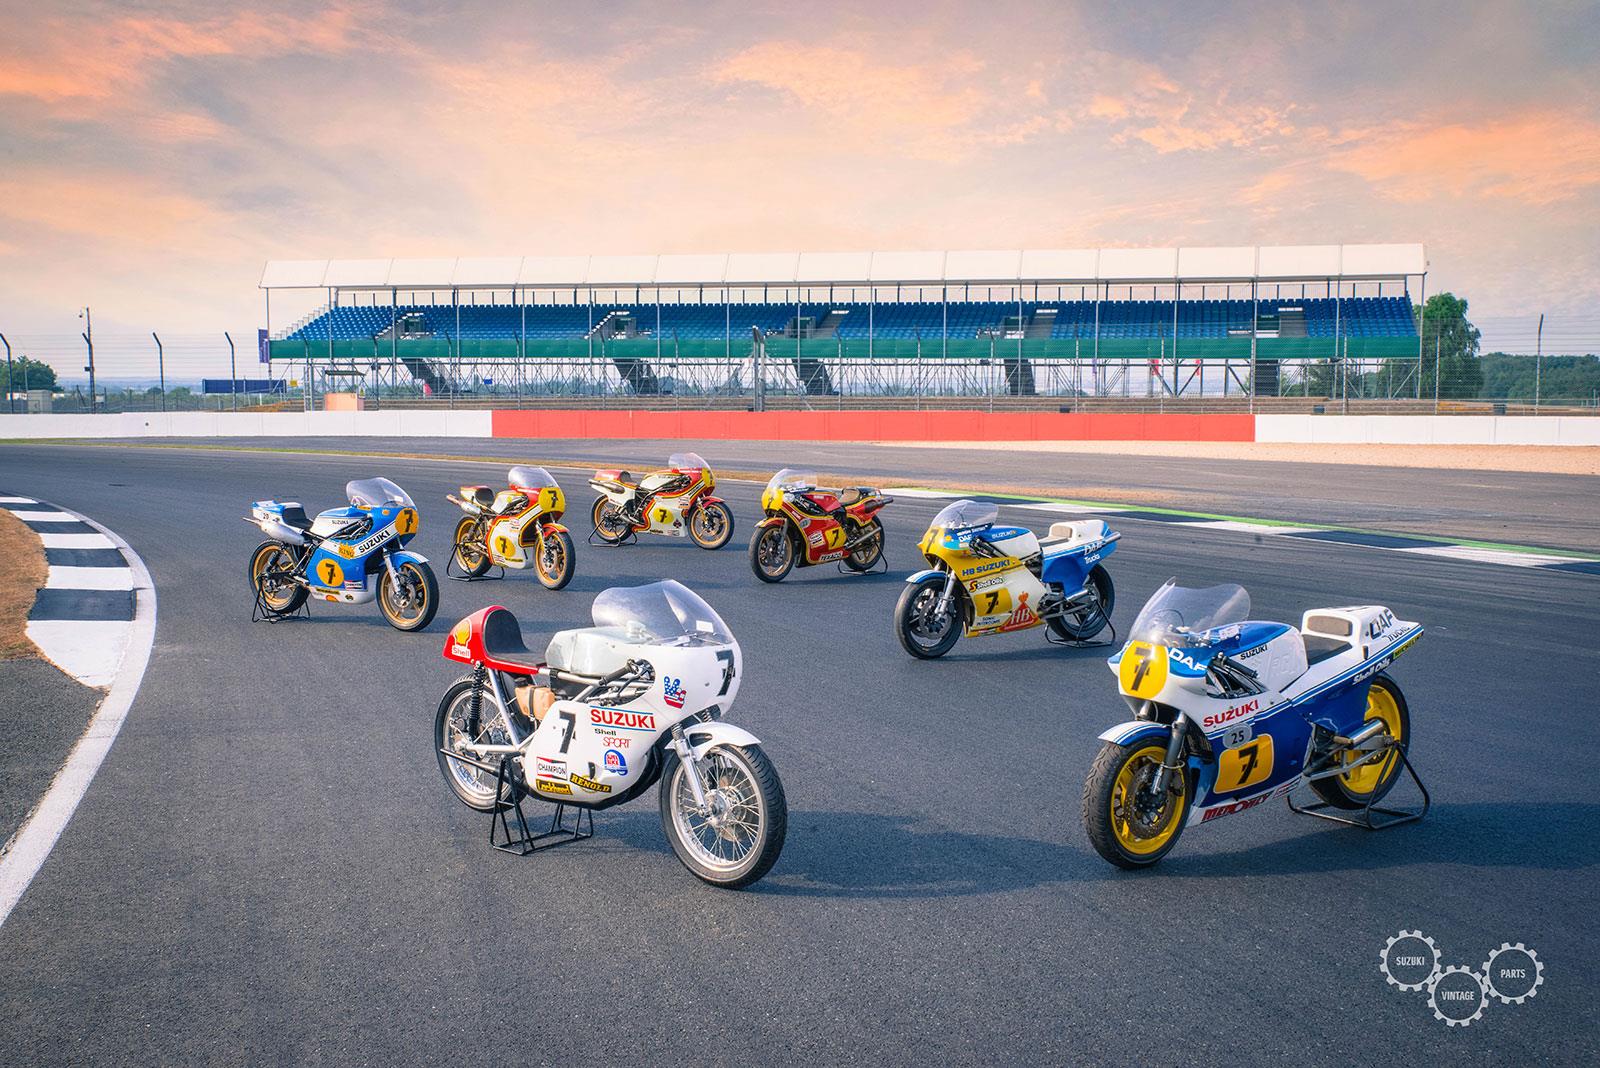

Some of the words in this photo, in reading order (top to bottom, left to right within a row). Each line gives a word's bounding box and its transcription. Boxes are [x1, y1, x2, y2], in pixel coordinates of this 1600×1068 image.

[547, 490, 558, 508] 7
[403, 509, 413, 532] 7
[658, 509, 667, 523] 7
[358, 530, 391, 553] SUZUKI
[499, 537, 507, 554] 7
[831, 529, 839, 546] 7
[926, 529, 939, 552] 7
[325, 562, 336, 585] 7
[962, 567, 975, 577] HB
[976, 559, 1011, 573] SUZUKI
[985, 591, 999, 615] 7
[1010, 607, 1030, 625] HB
[1369, 608, 1393, 640] DAF
[452, 647, 470, 657] Shell
[1168, 647, 1208, 672] DAF
[1240, 645, 1268, 660] SUZUKI
[716, 650, 736, 697] 7
[1131, 646, 1153, 691] 7
[1352, 665, 1375, 685] Shell
[590, 708, 656, 729] SUZUKI
[1203, 699, 1259, 728] SUZUKI
[559, 710, 577, 754] 7
[594, 728, 617, 736] Shell
[1231, 730, 1245, 745] 25
[602, 737, 632, 749] SPORT
[537, 763, 566, 775] CHAMPION
[1236, 744, 1259, 786] 7
[571, 774, 610, 793] RENOLD
